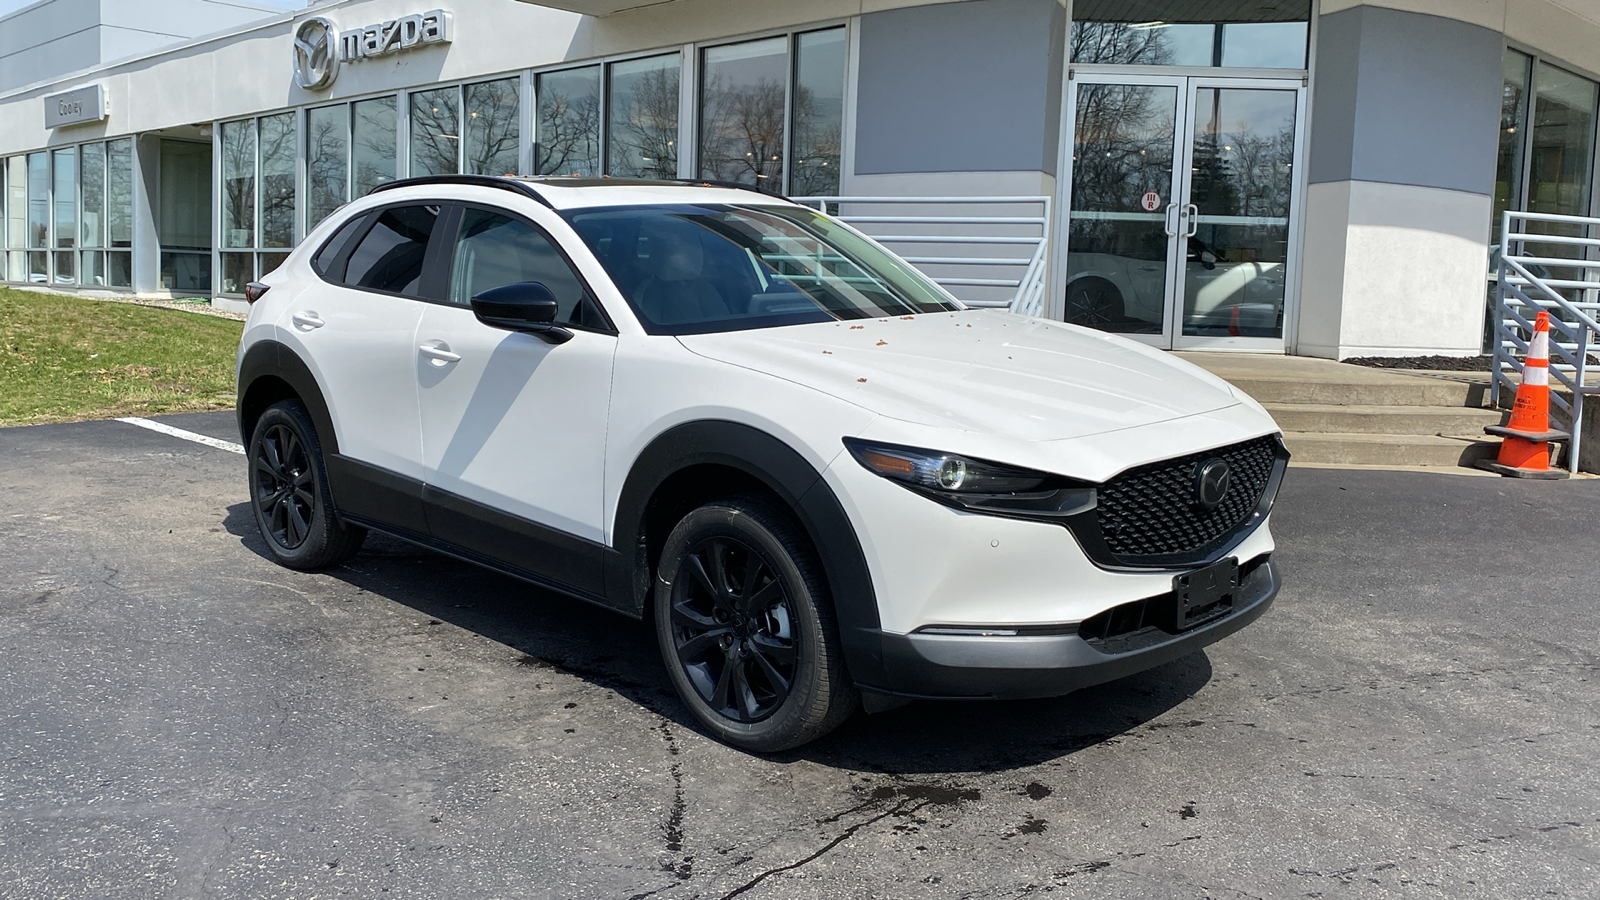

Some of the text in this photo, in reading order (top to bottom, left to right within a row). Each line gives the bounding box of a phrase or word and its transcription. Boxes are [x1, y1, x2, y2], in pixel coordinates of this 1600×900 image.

[340, 8, 452, 63] mazda
[58, 96, 83, 118] Cooley
[1147, 201, 1154, 209] R
